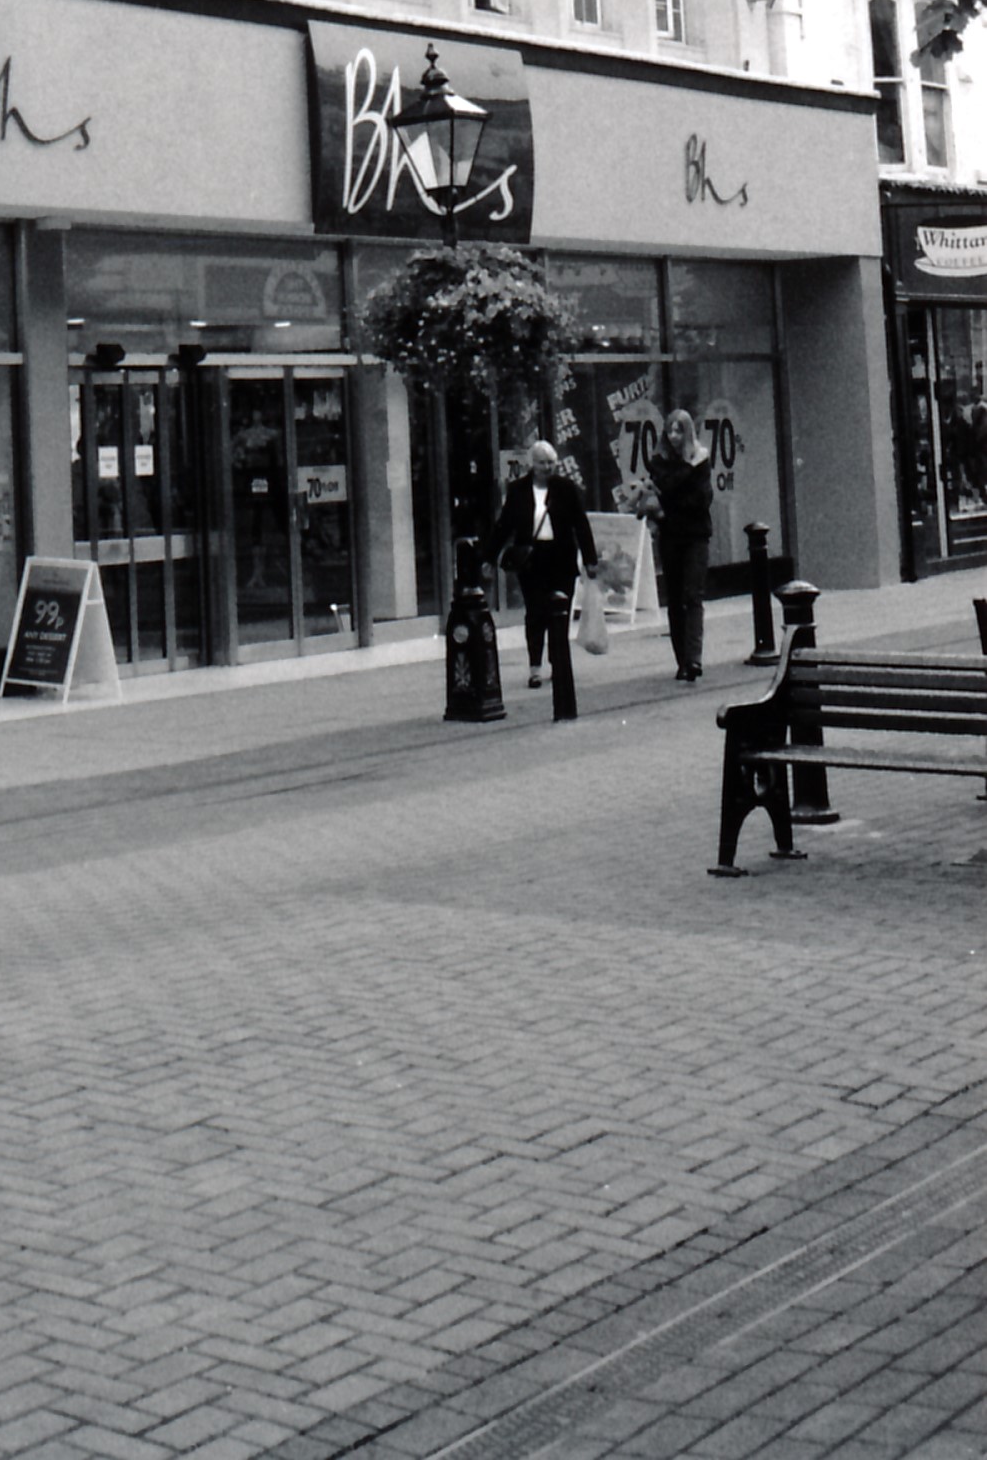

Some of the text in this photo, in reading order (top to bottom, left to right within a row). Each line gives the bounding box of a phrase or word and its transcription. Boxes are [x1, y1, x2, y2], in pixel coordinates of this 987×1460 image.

[342, 47, 518, 222] Bhs
[684, 133, 748, 209] Bhs
[716, 472, 734, 491] Off
